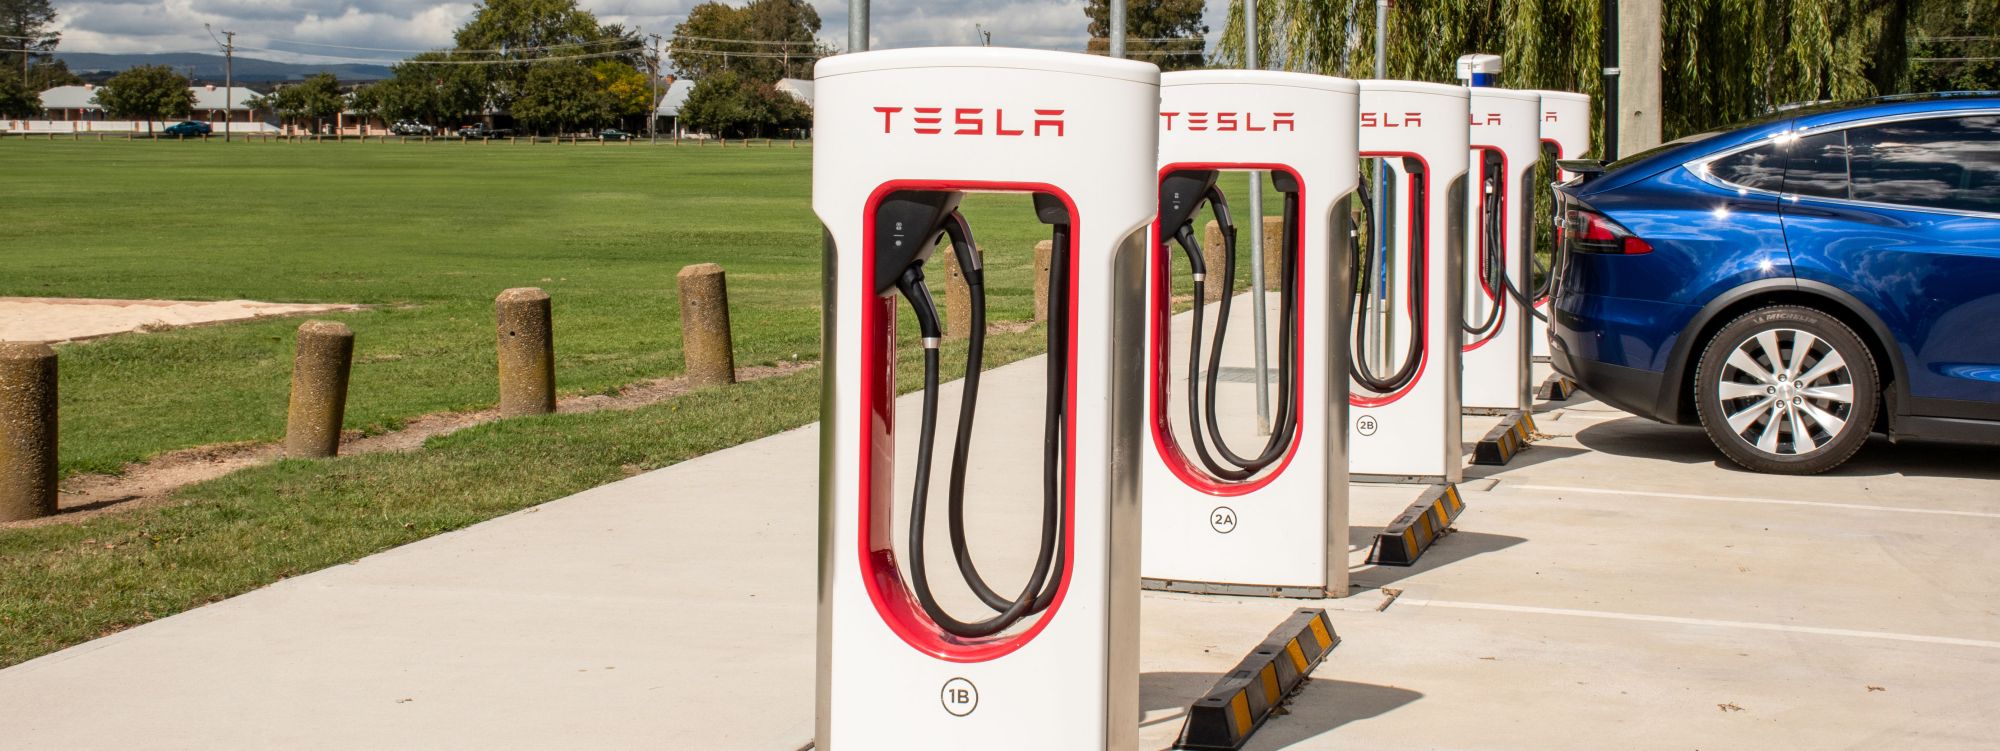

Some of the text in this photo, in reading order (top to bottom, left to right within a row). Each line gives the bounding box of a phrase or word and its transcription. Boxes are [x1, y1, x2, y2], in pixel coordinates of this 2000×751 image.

[873, 106, 1065, 138] TESLA
[1158, 111, 1295, 132] TESLA
[1360, 421, 1374, 430] 2B
[1214, 514, 1233, 526] 2A
[949, 689, 970, 705] 1B
